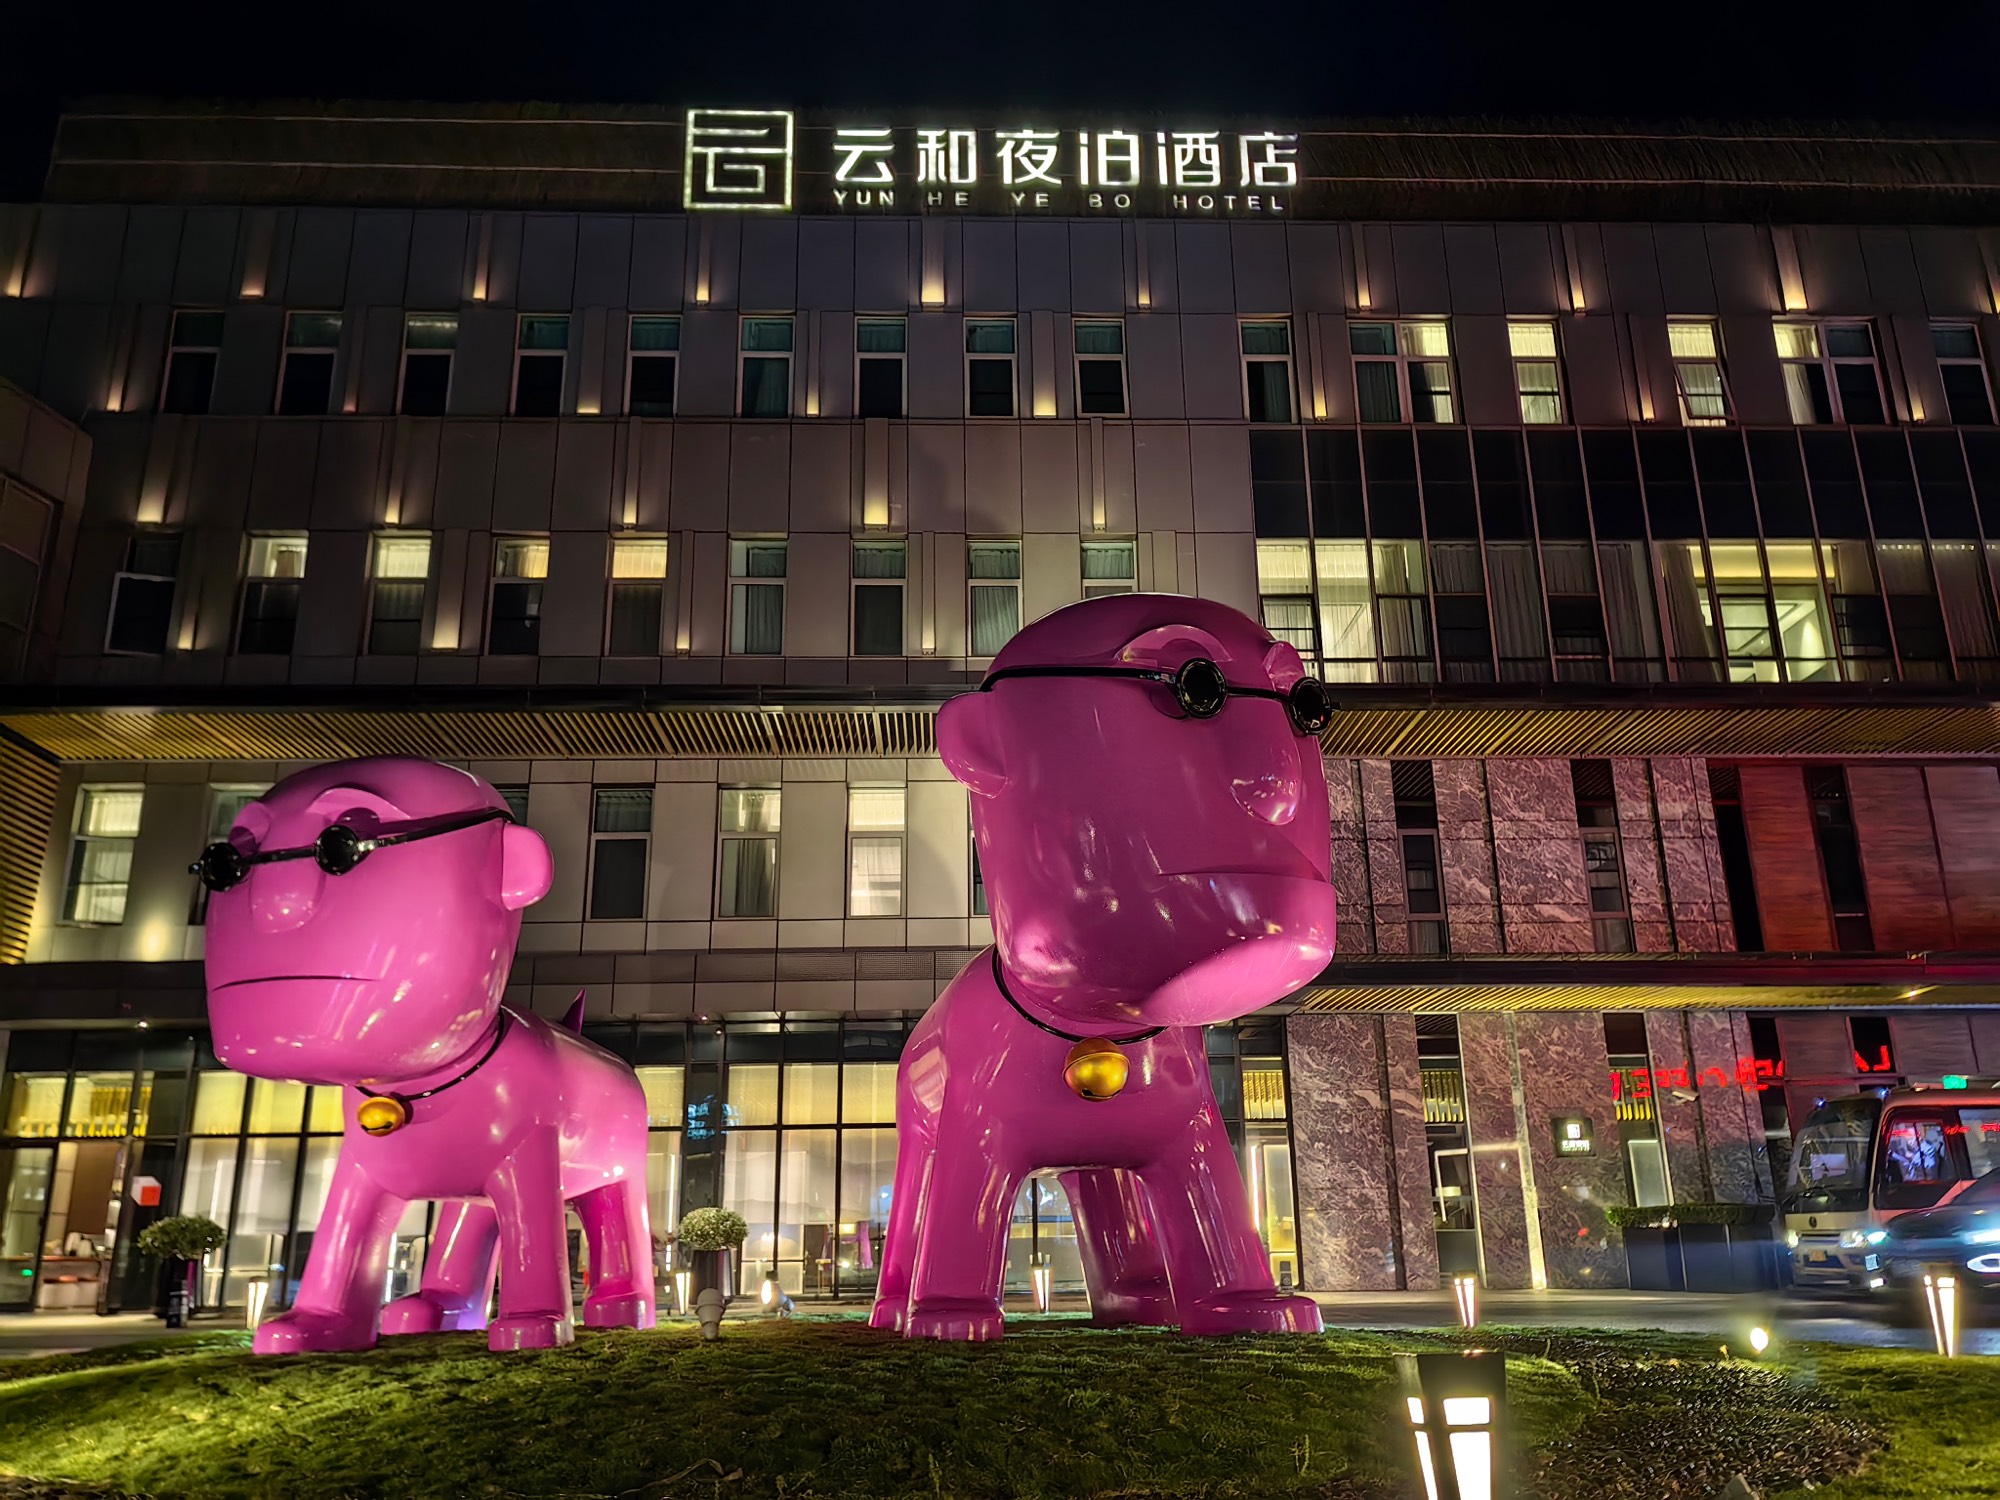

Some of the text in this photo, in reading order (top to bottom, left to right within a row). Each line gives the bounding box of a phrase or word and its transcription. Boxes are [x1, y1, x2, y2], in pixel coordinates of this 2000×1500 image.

[833, 128, 1298, 188] 云和夜泊酒店
[833, 190, 1283, 211] YUN HE YE BO HOTEL
